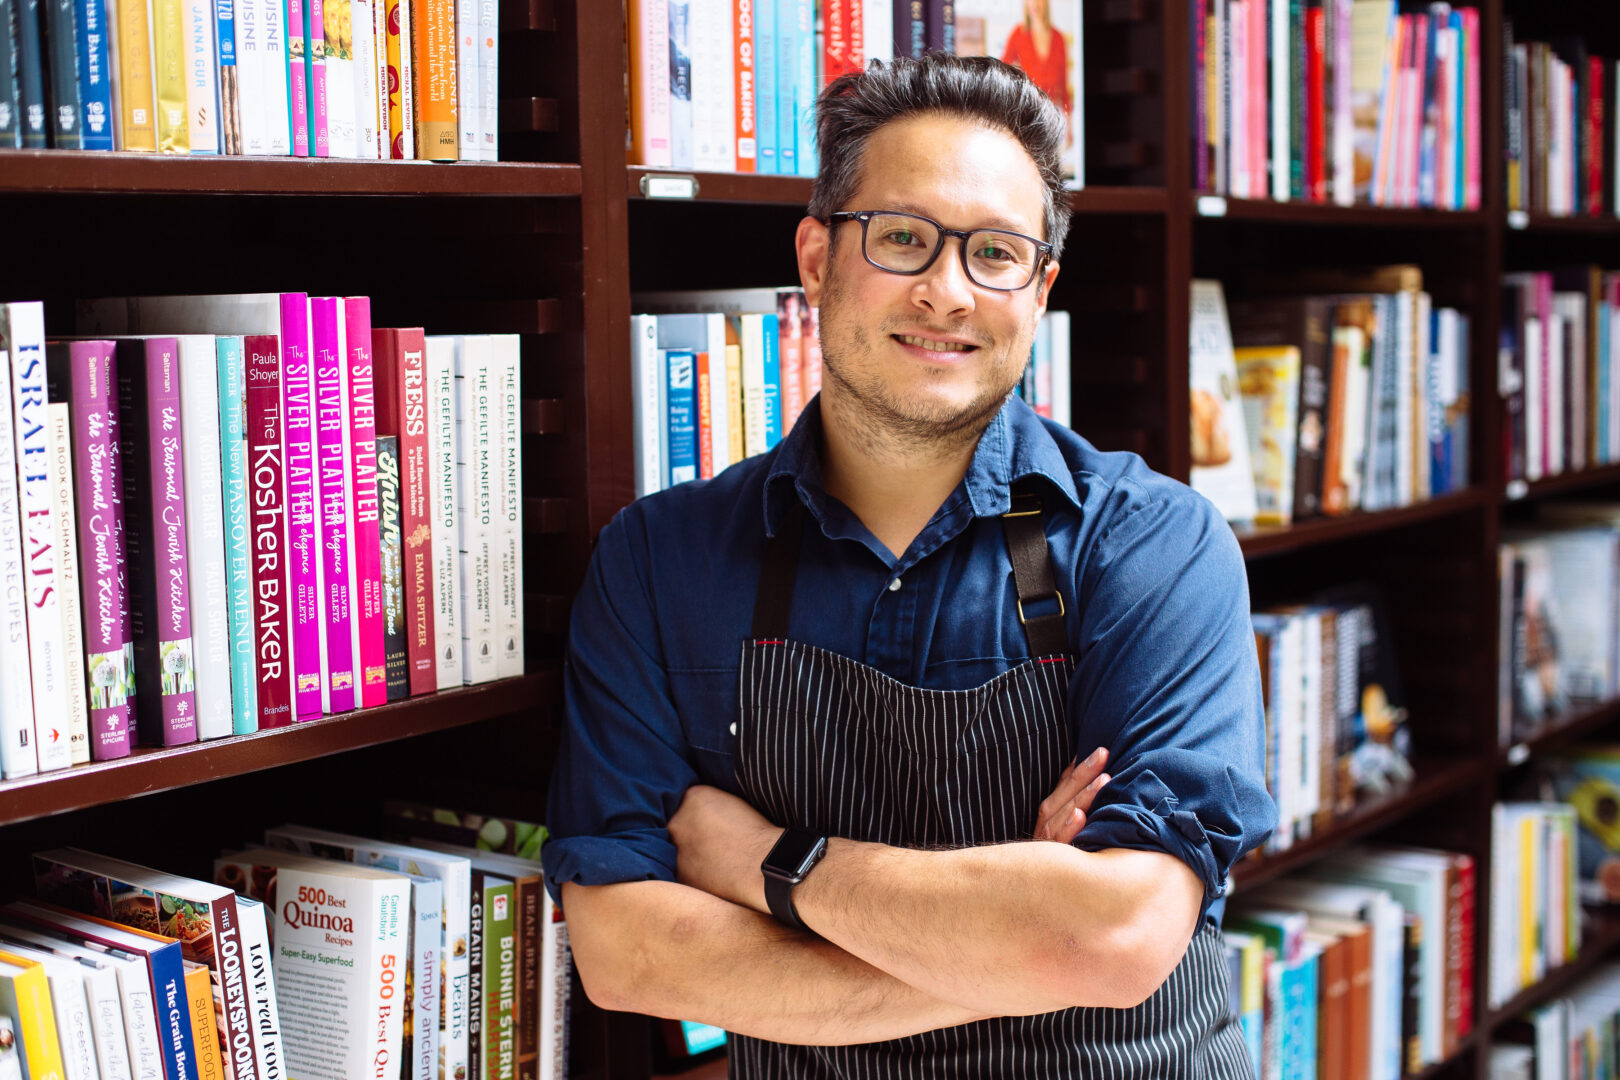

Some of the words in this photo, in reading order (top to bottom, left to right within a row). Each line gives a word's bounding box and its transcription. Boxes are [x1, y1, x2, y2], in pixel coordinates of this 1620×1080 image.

[192, 6, 204, 53] JANNA
[428, 23, 438, 58] Around
[448, 25, 457, 55] AND
[88, 34, 101, 86] BAKER
[195, 59, 206, 88] GUR
[430, 59, 439, 74] the
[436, 44, 447, 77] Recipes
[740, 42, 752, 68] OF
[430, 74, 440, 102] World
[439, 79, 449, 101] from
[449, 59, 458, 117] HONEY
[740, 71, 753, 133] BAKING
[440, 138, 454, 146] HMH
[252, 351, 278, 365] Paula
[287, 346, 304, 358] The
[319, 349, 336, 362] The
[353, 347, 369, 360] The
[88, 357, 98, 399] Saltsman
[162, 352, 172, 393] Saltsman
[227, 351, 237, 397] SHOYER
[249, 368, 280, 384] Shoyer
[441, 369, 450, 393] THE
[479, 366, 488, 391] THE
[506, 365, 516, 389] THE
[286, 364, 310, 428] SILVER
[318, 367, 341, 431] SILVER
[352, 365, 374, 428] SILVER
[404, 350, 425, 437] FRESS
[700, 373, 710, 425] DONUT
[763, 383, 778, 434] flour
[19, 344, 48, 498] ISRAEL
[56, 418, 65, 440] THE
[88, 412, 105, 438] the
[162, 406, 178, 431] the
[228, 405, 241, 434] The
[264, 403, 279, 439] The
[442, 397, 452, 449] GEFILTE
[479, 395, 489, 446] GEFILTE
[507, 393, 516, 443] GEFILTE
[57, 447, 67, 483] BOOK
[162, 437, 180, 502] Seasonal
[199, 434, 215, 488] KOSHER
[230, 440, 242, 475] New
[408, 456, 417, 483] Jewish
[416, 446, 424, 467] Bold
[87, 443, 109, 511] Seasonal
[289, 441, 313, 525] PLATTER
[321, 443, 345, 526] PLATTER
[355, 441, 379, 523] PLATTER
[416, 467, 425, 496] flavors
[443, 453, 454, 529] MANIFESTO
[481, 450, 490, 526] MANIFESTO
[508, 447, 517, 522] MANIFESTO
[59, 489, 68, 506] OF
[201, 493, 218, 539] BAKER
[376, 451, 400, 547] Knish
[410, 484, 419, 516] kitchen
[417, 496, 426, 518] from
[60, 511, 73, 581] SCHMALTZ
[90, 514, 114, 575] Jewish
[163, 506, 182, 564] Jewish
[230, 478, 249, 583] PASSOVER
[28, 509, 55, 608] EATS
[294, 528, 314, 575] elegance
[326, 528, 346, 575] elegance
[380, 546, 394, 583] Jewish
[446, 545, 454, 577] JEFFREY
[475, 563, 483, 577] LIZ
[482, 542, 490, 573] JEFFREY
[502, 559, 510, 573] LIZ
[509, 538, 517, 570] JEFFREY
[205, 561, 221, 606] PAULA
[415, 553, 426, 595] EMMA
[439, 567, 447, 580] LIZ
[503, 575, 511, 607] ALPERN
[6, 561, 22, 642] RECIPES
[95, 578, 117, 646] Kitchen
[166, 568, 186, 633] Kitchen
[298, 584, 308, 625] GILLETZ
[307, 585, 315, 619] SILVER
[331, 583, 340, 624] GILLETZ
[340, 585, 348, 619] SILVER
[363, 579, 373, 619] GILLETZ
[373, 580, 381, 614] SILVER
[383, 583, 397, 607] Soul
[439, 582, 448, 615] ALPERN
[446, 579, 455, 628] YOSKOWITZ
[475, 579, 484, 611] ALPERN
[482, 575, 491, 624] YOSKOWITZ
[509, 571, 518, 620] YOSKOWITZ
[65, 599, 78, 656] MICHAEL
[208, 609, 224, 664] SHOYER
[234, 590, 251, 655] MENU
[386, 607, 397, 636] Food
[416, 596, 428, 648] SPITZER
[69, 660, 81, 723] RUHLMAN
[263, 704, 290, 715] Brandeis
[101, 730, 126, 739] STERLING
[170, 714, 194, 723] STERLING
[172, 723, 193, 731] EPICURE
[102, 739, 124, 747] EPICURE
[298, 886, 326, 906] 500
[328, 895, 346, 908] Best
[389, 895, 400, 928] Camilla
[420, 912, 440, 921] Speck
[525, 895, 536, 937] BEAN
[221, 908, 231, 929] THE
[283, 901, 354, 933] Quinoa
[378, 895, 389, 941] Saulsbury
[389, 931, 399, 940] V.
[471, 903, 482, 966] GRAIN
[281, 946, 316, 963] Super-Easy
[317, 953, 355, 968] Superfood
[325, 933, 353, 947] Recipes
[249, 943, 270, 994] LOVE
[380, 954, 396, 1000] 500
[420, 950, 436, 1012] simply
[500, 936, 514, 1011] BONNIE
[525, 949, 536, 989] BEAN
[165, 979, 176, 1008] The
[453, 973, 468, 1040] beans
[471, 972, 481, 1034] MAINS
[169, 1009, 184, 1048] Grain
[257, 999, 278, 1037] real
[377, 1005, 392, 1044] Best
[499, 1016, 513, 1080] STERN
